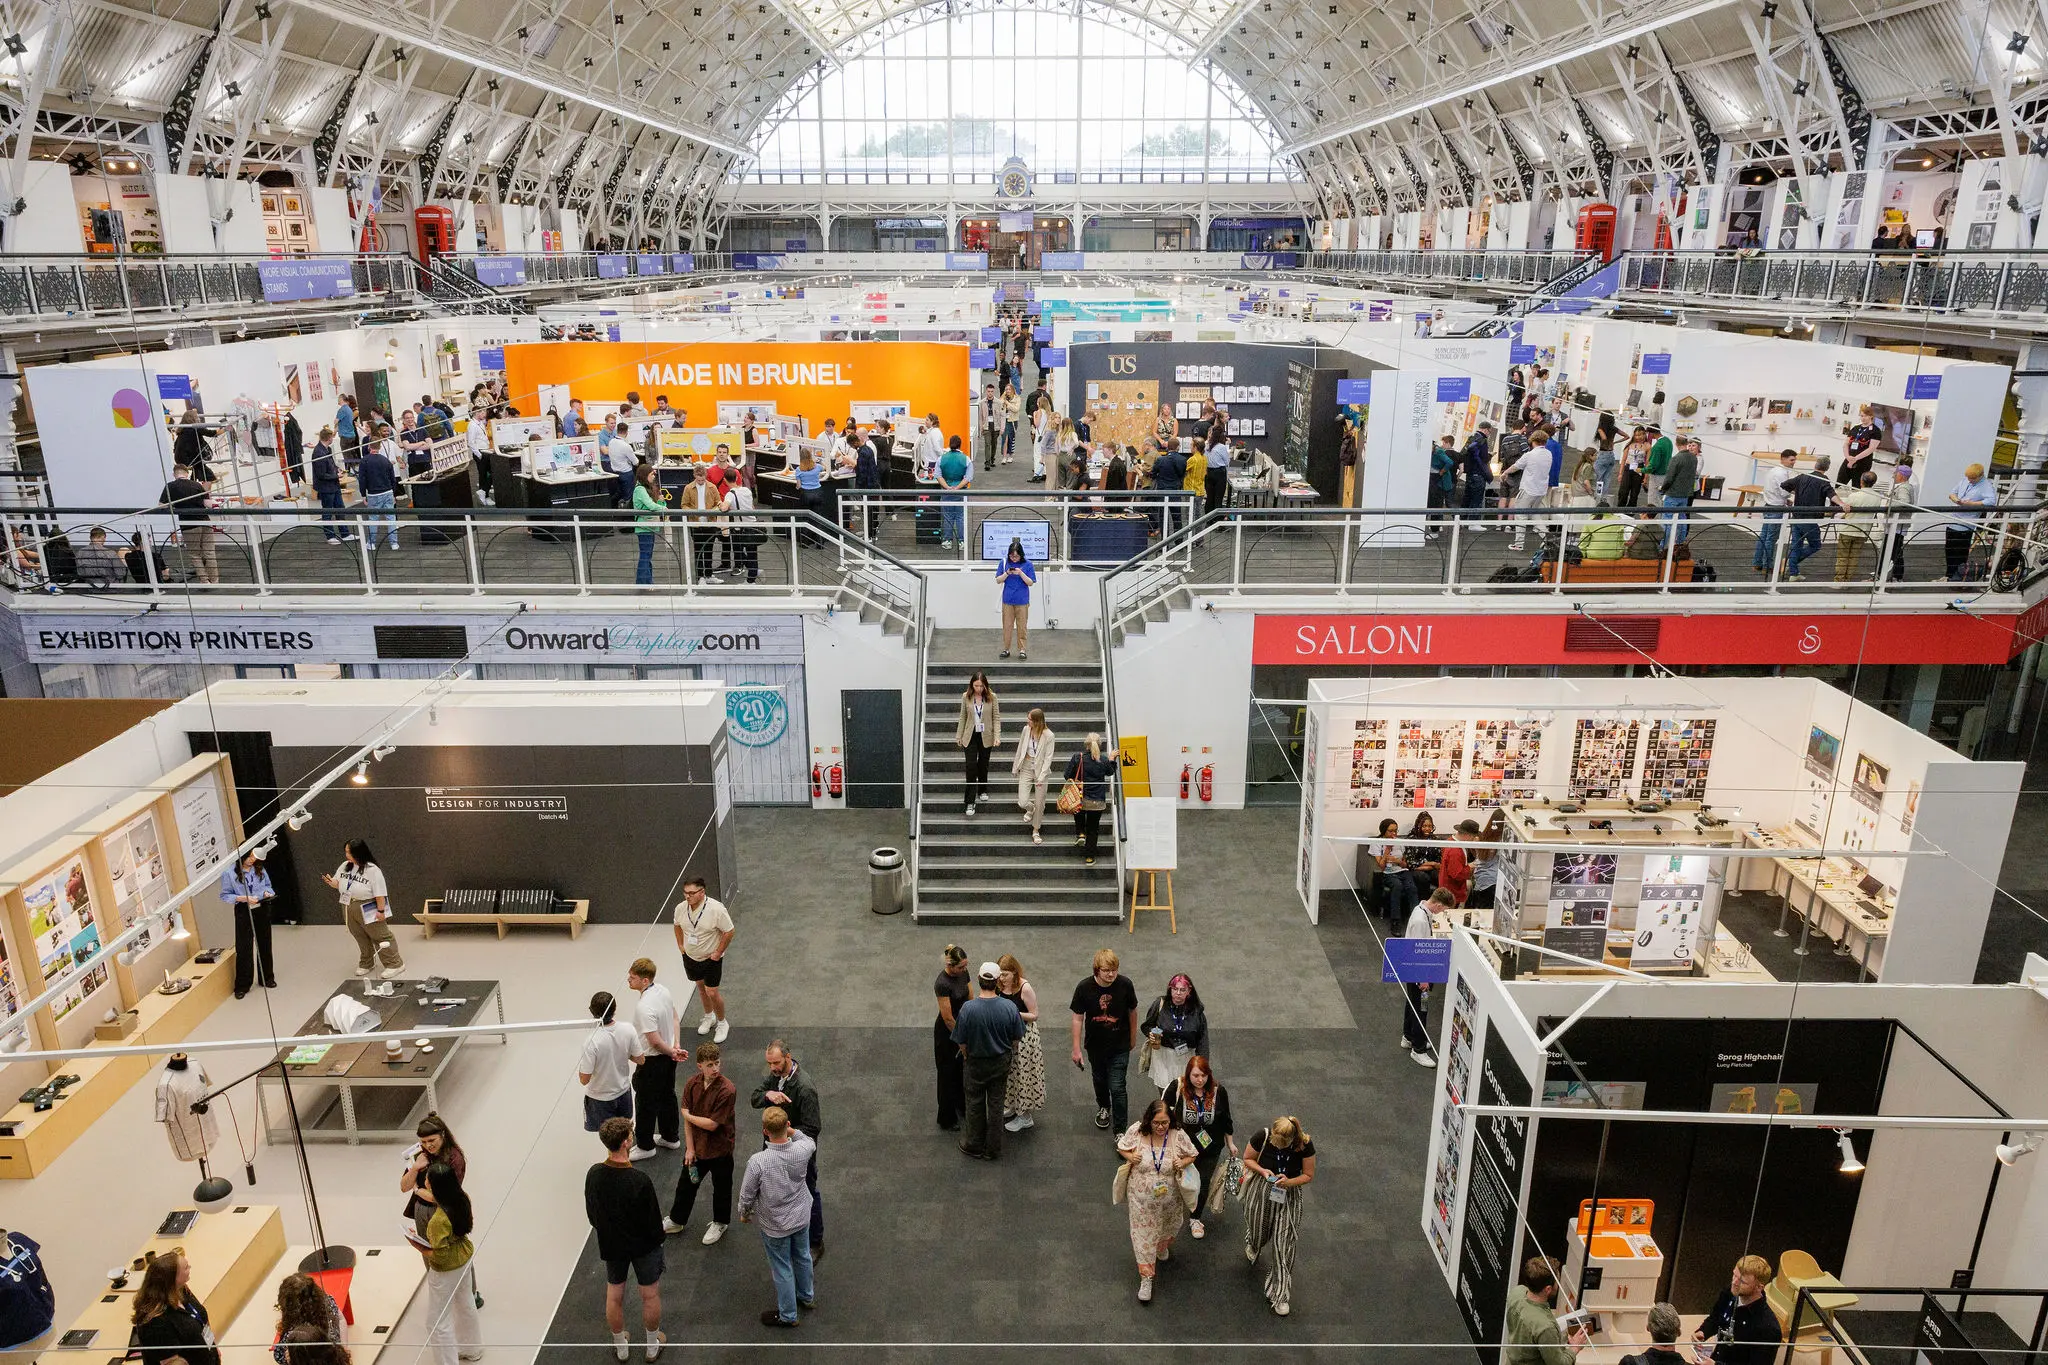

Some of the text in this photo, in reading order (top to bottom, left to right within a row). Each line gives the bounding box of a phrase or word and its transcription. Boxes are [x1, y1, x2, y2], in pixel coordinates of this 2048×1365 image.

[262, 265, 346, 277] MORE VISUAL COMMUNICATIONS
[265, 282, 288, 294] STANDS
[637, 363, 852, 385] MADE IN BRUNEL
[1108, 354, 1137, 374] US
[1846, 363, 1884, 375] UNIVERSITY OF
[1844, 371, 1883, 387] PLYMOUTH
[1413, 381, 1422, 405] SCHOOL
[1420, 381, 1430, 424] MANCHESTER
[39, 631, 313, 650] EXHIBITION PRINTERS
[1296, 625, 1433, 655] SALONI
[740, 700, 765, 722] 20
[431, 800, 562, 808] DESIGN FOR INDUSTRY
[1717, 1053, 1783, 1062] Sprog Highchair
[1491, 1115, 1516, 1172] Design
[1925, 1316, 1941, 1337] ARID
